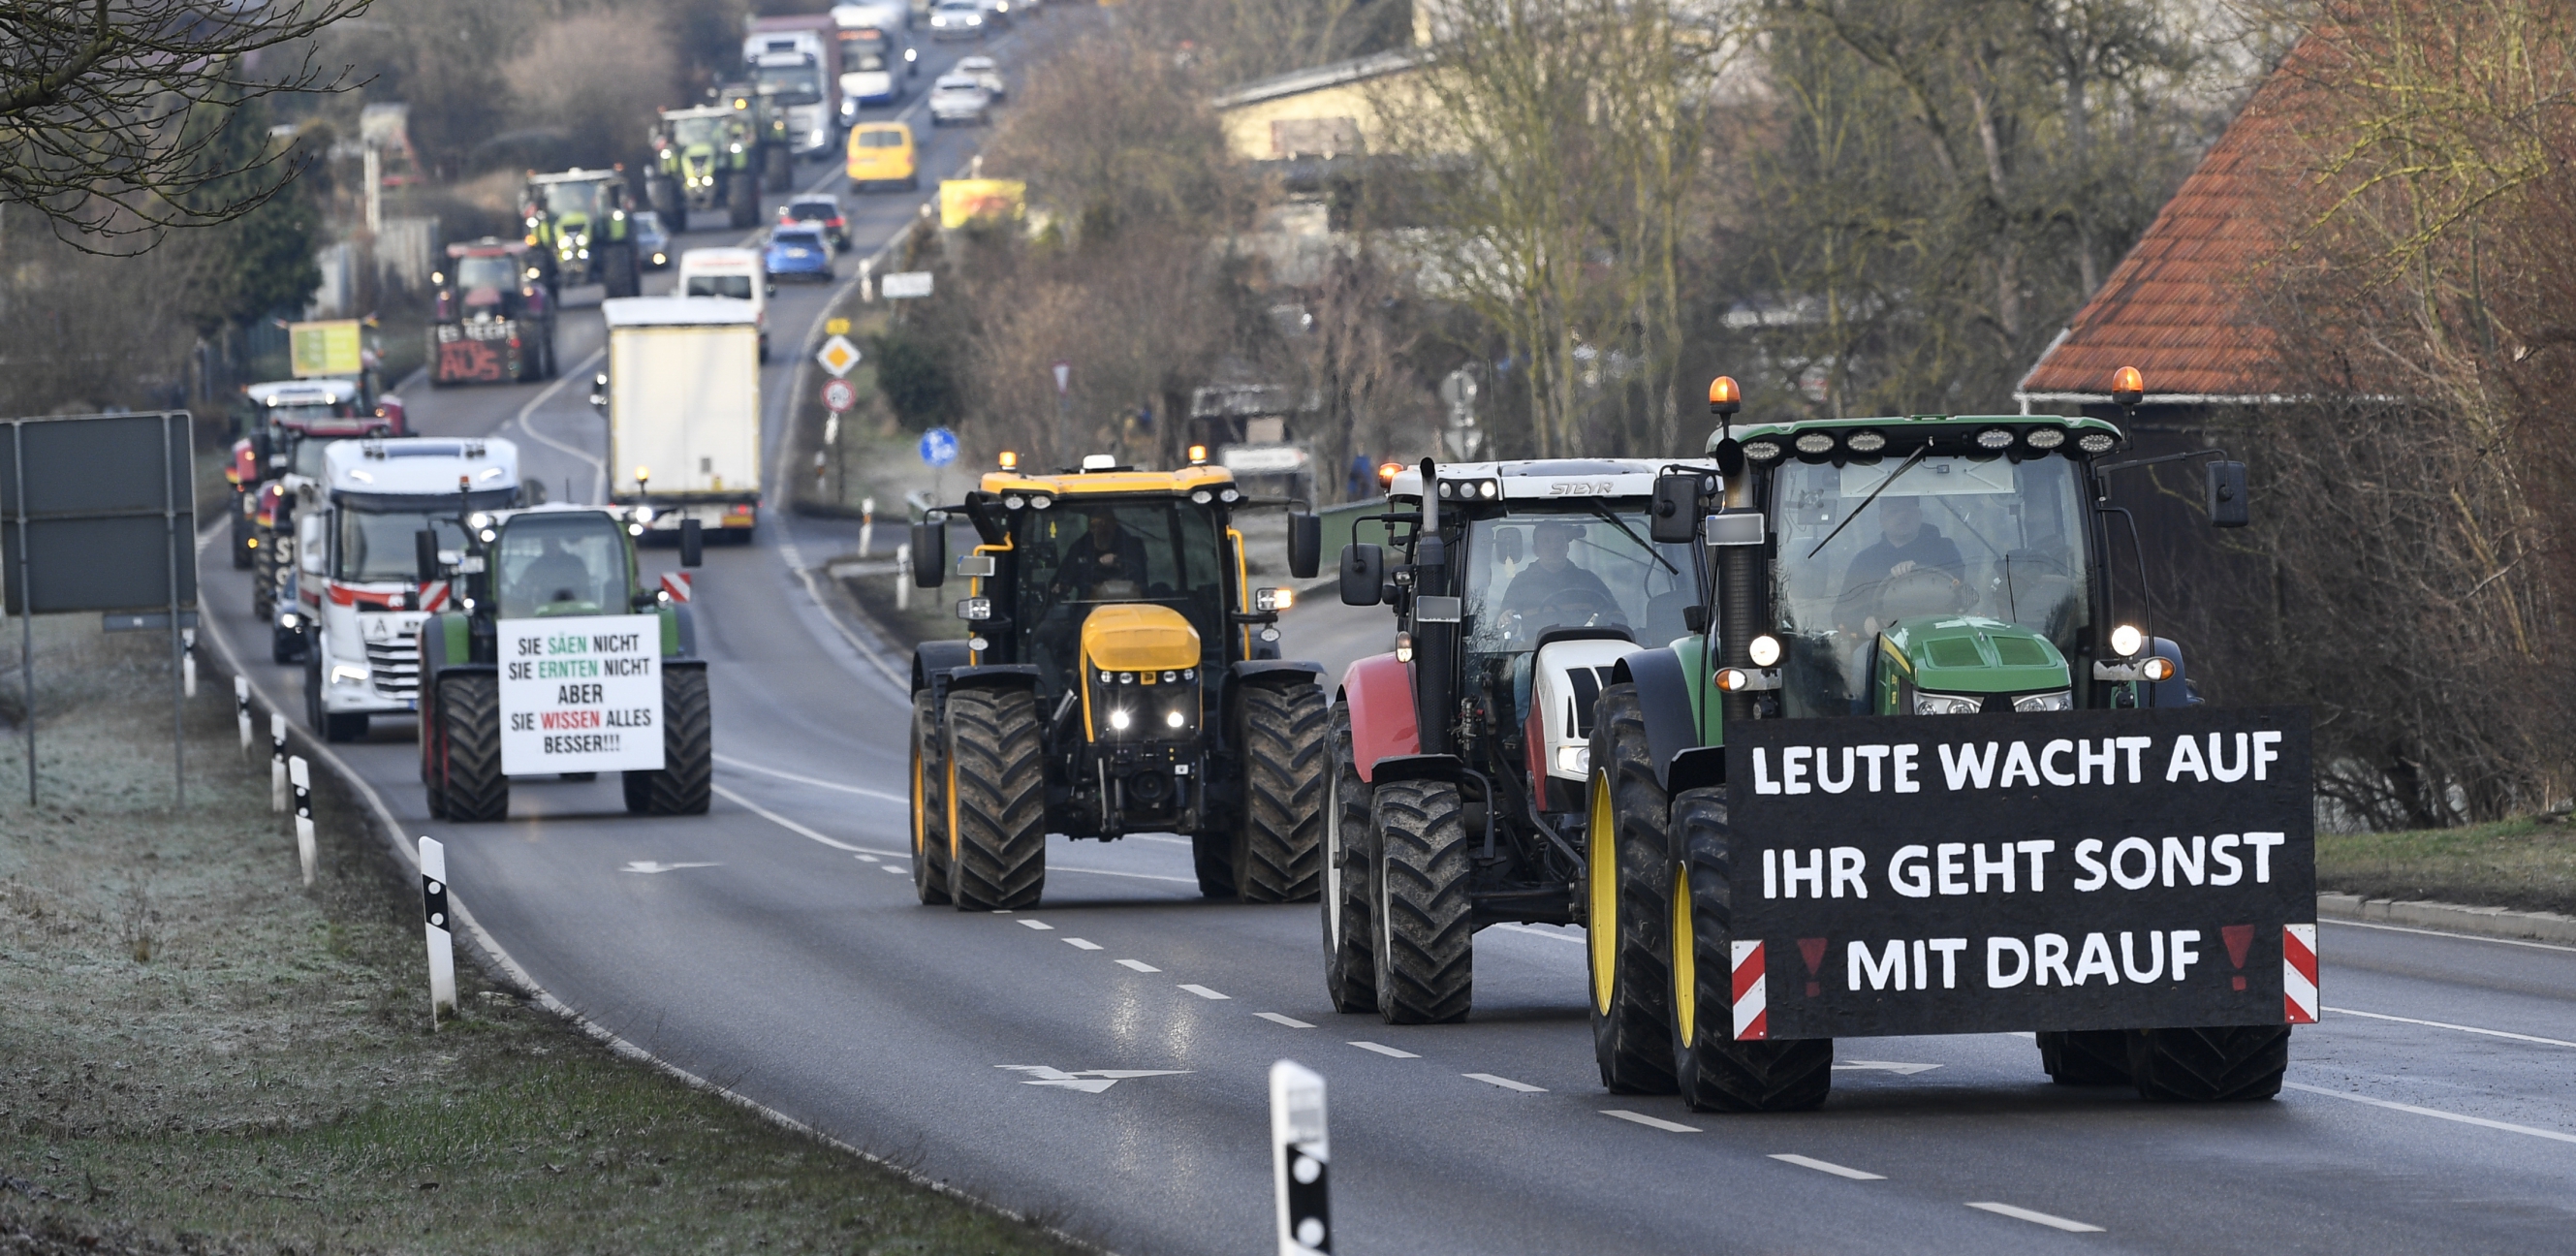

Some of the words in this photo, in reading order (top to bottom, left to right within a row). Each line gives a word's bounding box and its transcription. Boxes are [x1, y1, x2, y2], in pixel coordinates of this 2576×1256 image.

[1550, 483, 1614, 495] STEYR
[518, 638, 541, 655] SIE
[548, 633, 586, 654] SÄEN
[593, 635, 639, 652] NICHT
[509, 662, 531, 680] SIE
[539, 660, 598, 678] ERNTEN
[604, 658, 649, 675] NICHT
[558, 684, 603, 704] ABER
[511, 713, 534, 731] SIE
[541, 711, 600, 730] WISSEN
[606, 709, 651, 727] ALLES
[544, 735, 619, 753] BESSER!!!
[1752, 743, 1920, 795] LEUTE
[1937, 737, 2152, 791] WACHT
[2165, 731, 2282, 783] AUF
[1762, 846, 1869, 899] IHR
[1888, 840, 2056, 898] GEHT
[2074, 832, 2285, 893] SONST
[1847, 937, 1967, 991] MIT
[1987, 929, 2201, 989] DRAUF
